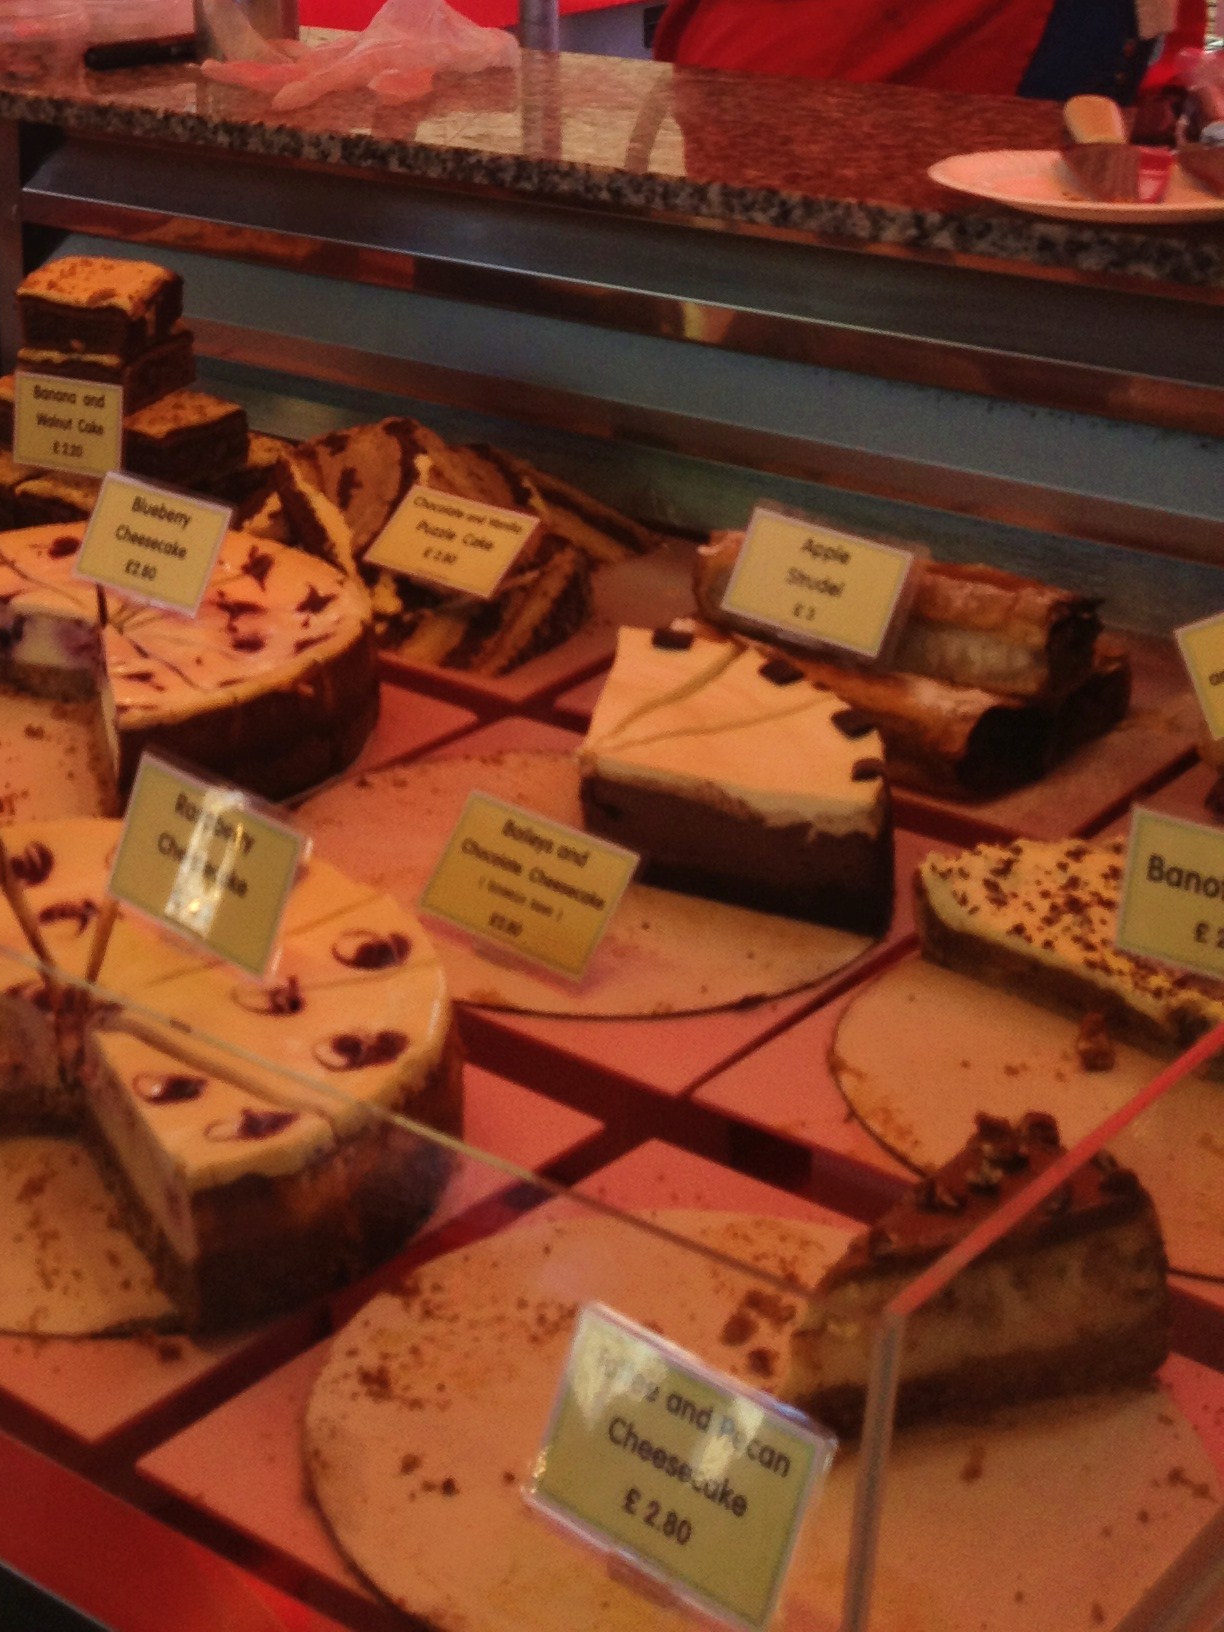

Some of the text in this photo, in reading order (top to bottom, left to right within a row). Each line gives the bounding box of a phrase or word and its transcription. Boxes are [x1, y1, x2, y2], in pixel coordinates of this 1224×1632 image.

[33, 384, 105, 408] Banana and
[78, 419, 104, 436] Cake
[132, 495, 191, 531] Blueberry
[115, 523, 187, 560] Cheesecake
[462, 532, 495, 552] Cake
[800, 536, 852, 566] Apple
[556, 844, 590, 869] and
[461, 836, 523, 877] Chocolate
[529, 866, 607, 911] Cheesecake
[666, 1389, 714, 1433] and
[643, 1498, 694, 1547] 2.80
